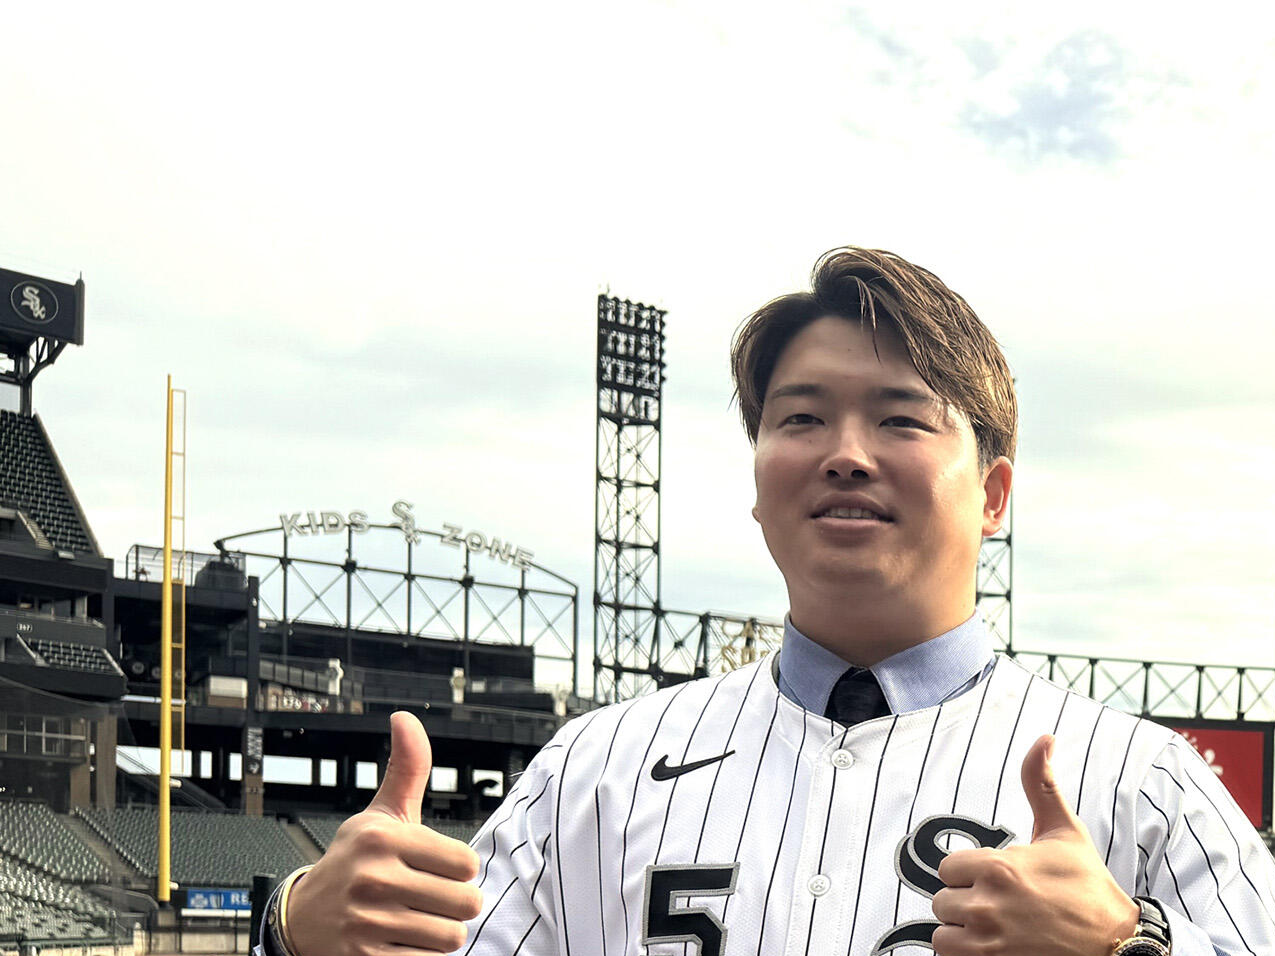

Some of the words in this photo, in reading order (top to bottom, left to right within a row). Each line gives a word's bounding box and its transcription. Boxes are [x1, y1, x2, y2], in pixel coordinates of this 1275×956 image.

[280, 511, 370, 537] KIDS
[441, 522, 535, 573] ZONE
[230, 893, 252, 906] RE
